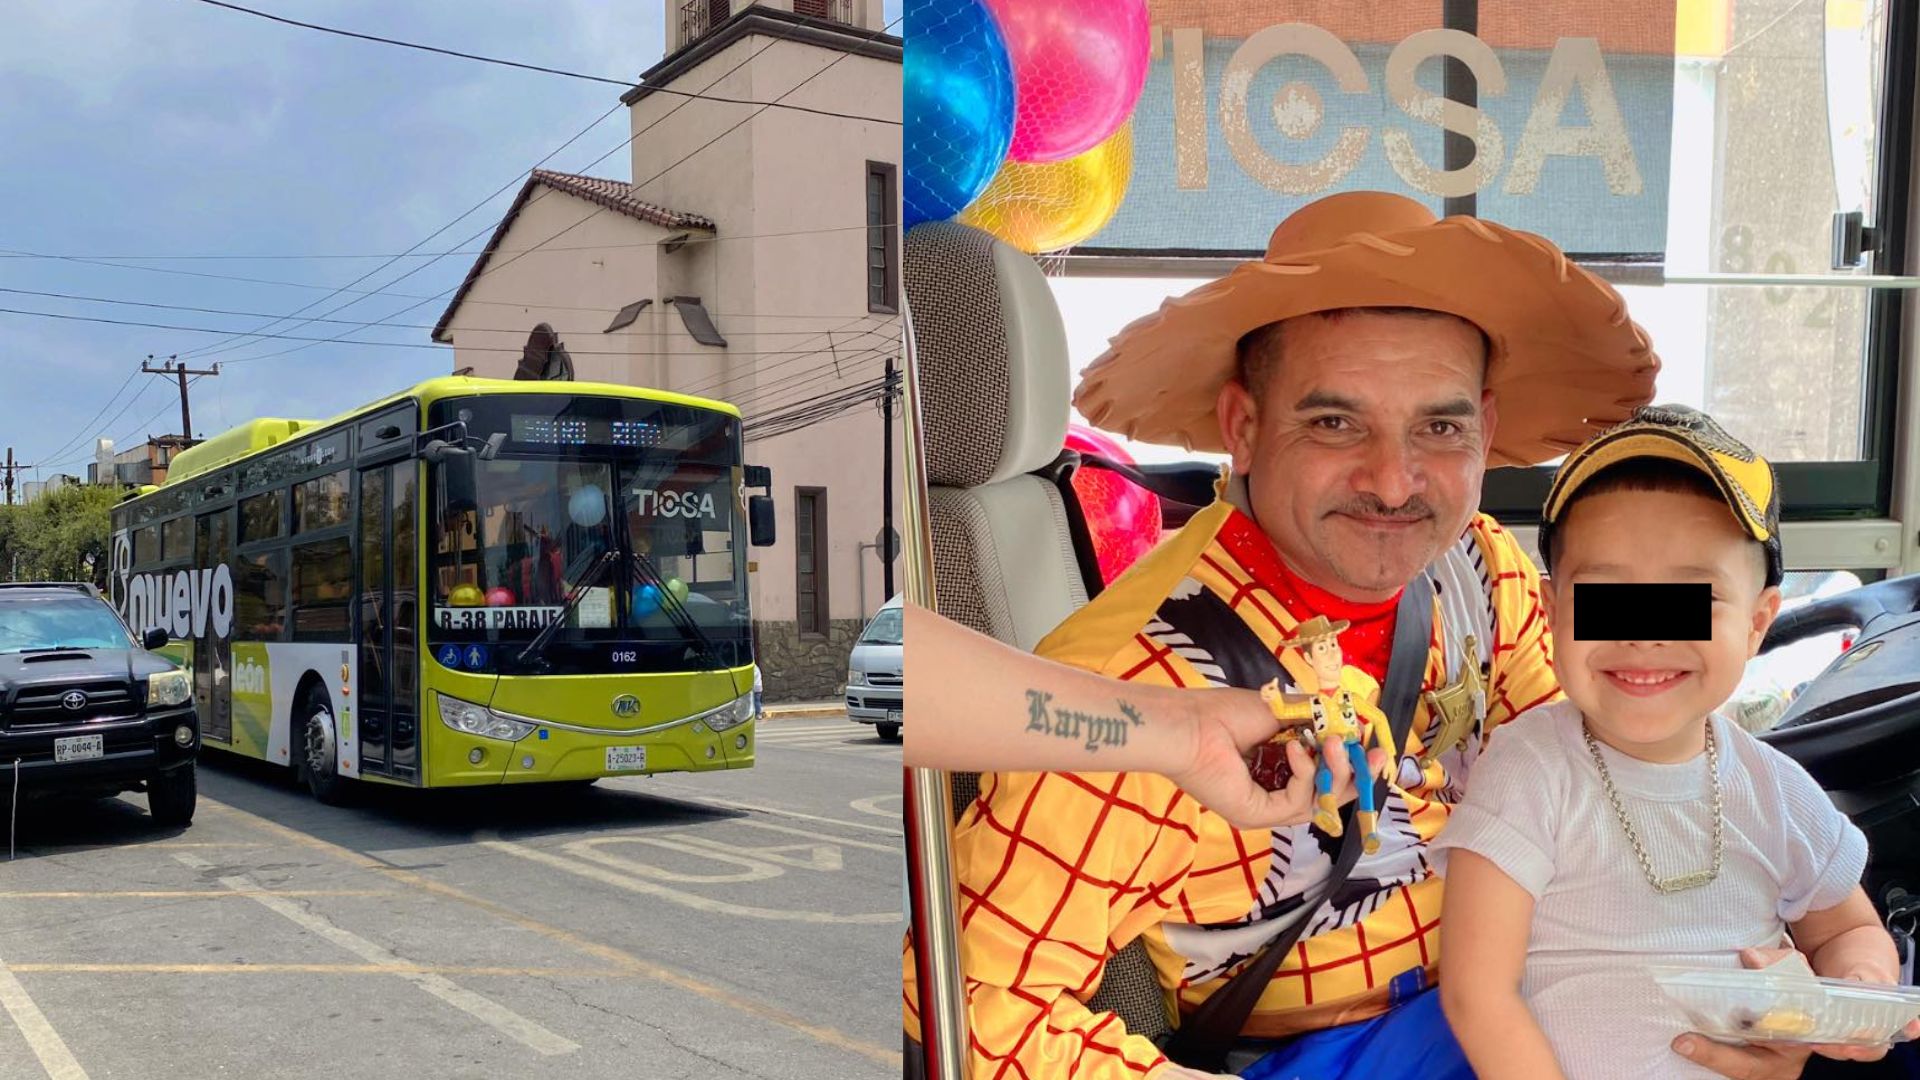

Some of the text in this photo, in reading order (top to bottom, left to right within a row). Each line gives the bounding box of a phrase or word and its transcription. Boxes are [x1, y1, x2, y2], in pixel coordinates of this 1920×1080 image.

[1151, 22, 1644, 198] ICSA
[440, 610, 486, 630] R-38
[612, 652, 636, 662] 0162
[1025, 687, 1129, 753] Karym
